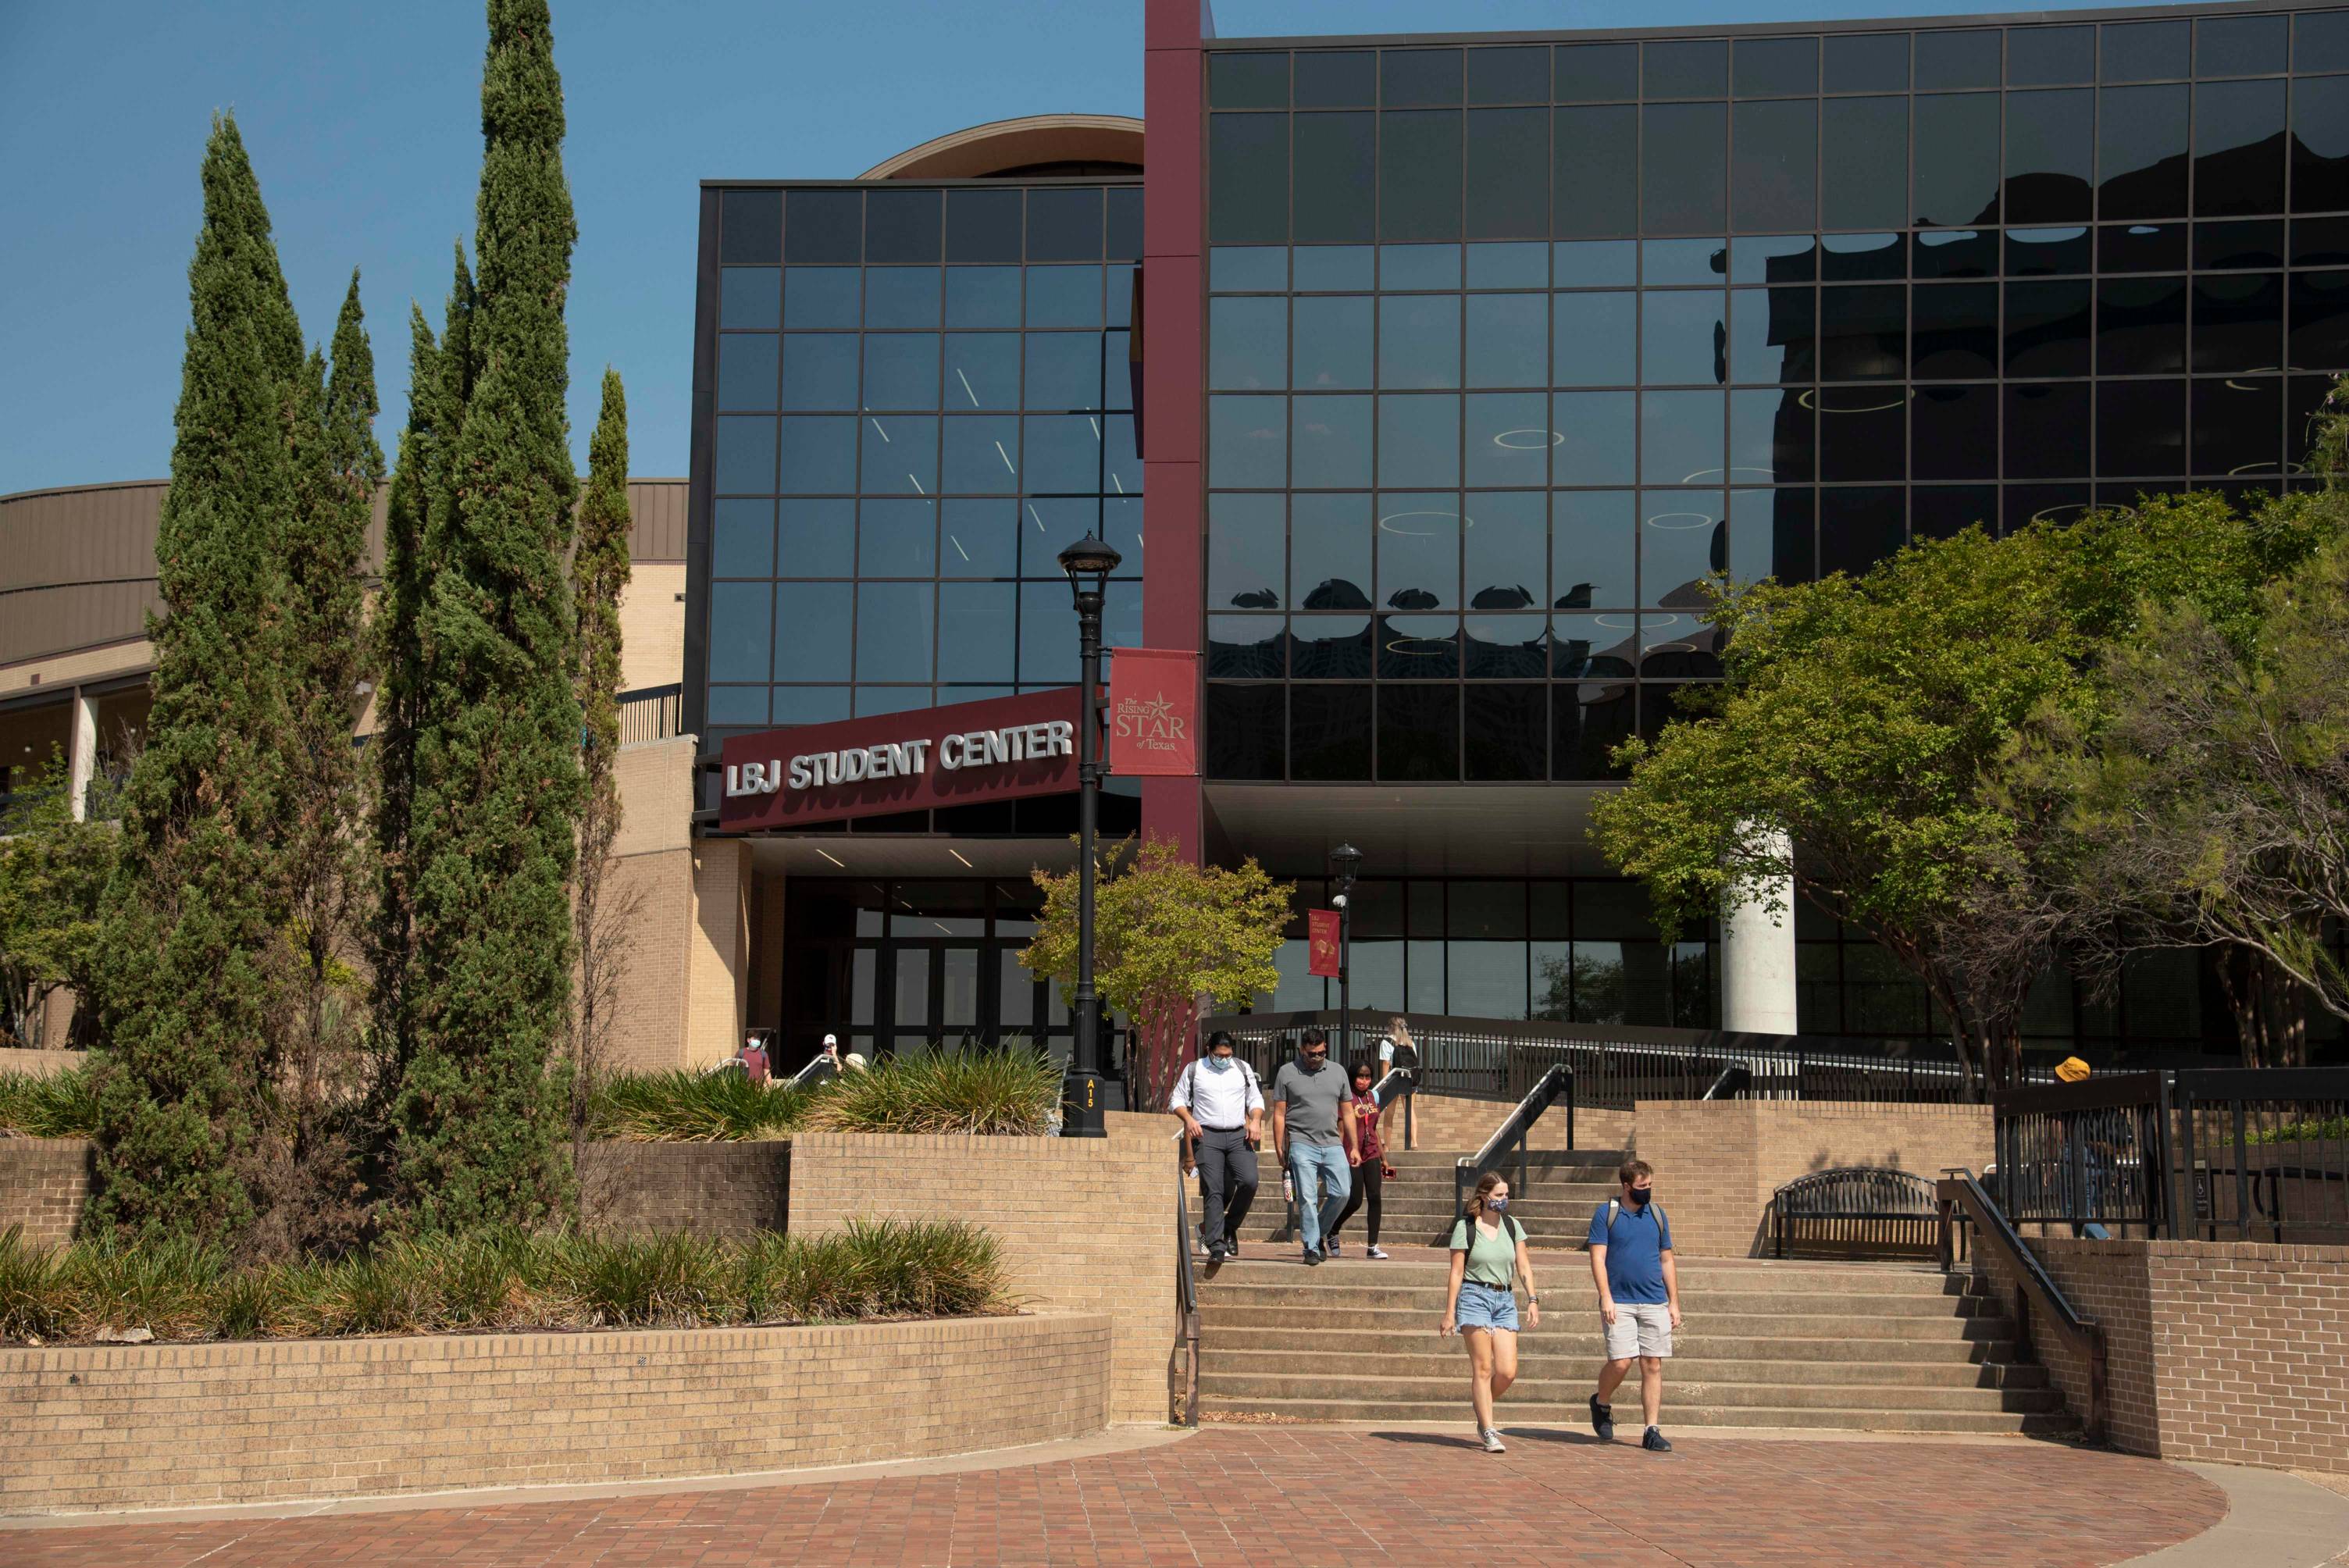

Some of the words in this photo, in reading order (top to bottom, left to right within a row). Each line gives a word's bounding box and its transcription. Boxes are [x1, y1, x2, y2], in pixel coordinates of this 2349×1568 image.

[1117, 703, 1150, 715] RISING
[1116, 714, 1188, 739] STAR
[1136, 739, 1146, 750] of
[1146, 738, 1175, 750] Texas
[726, 759, 781, 797] LBJ
[789, 738, 932, 790] STUDENT
[939, 720, 1073, 771] CENTER
